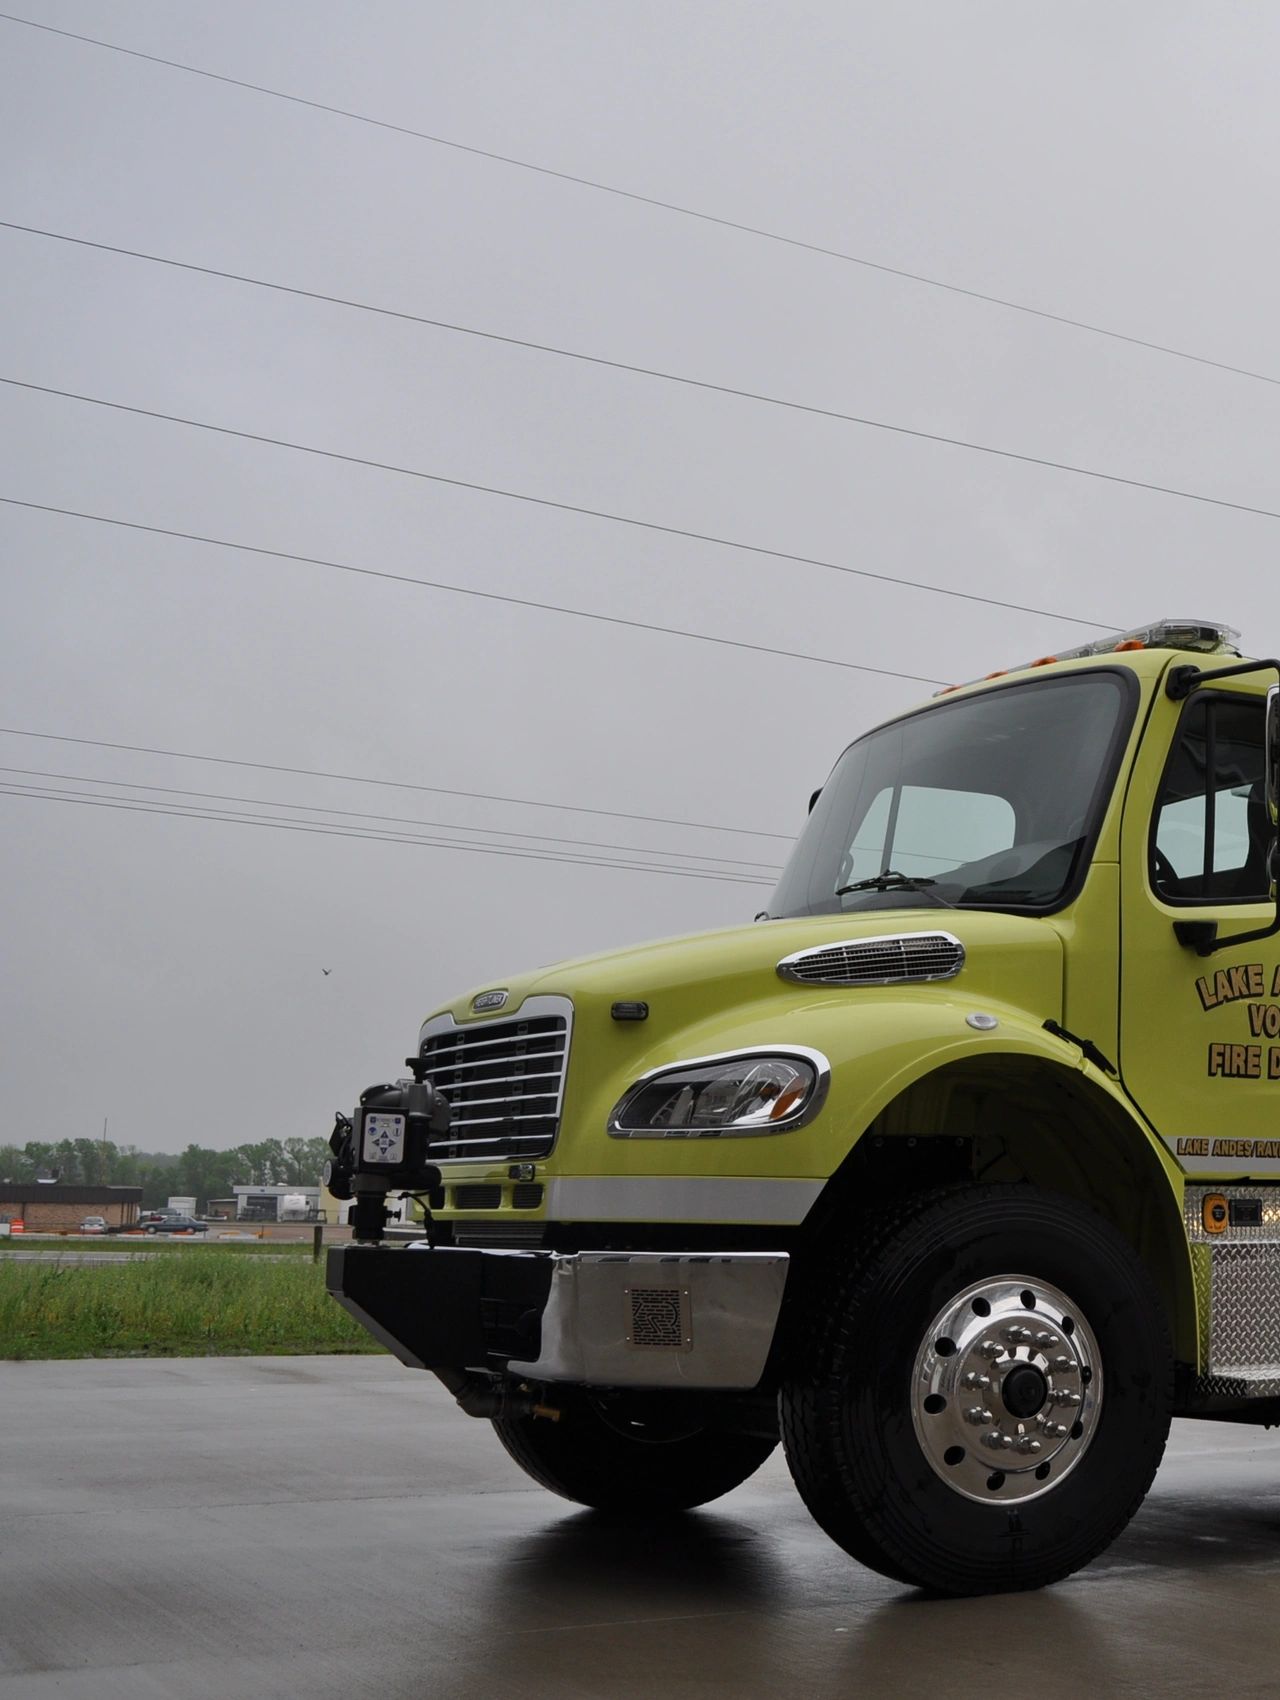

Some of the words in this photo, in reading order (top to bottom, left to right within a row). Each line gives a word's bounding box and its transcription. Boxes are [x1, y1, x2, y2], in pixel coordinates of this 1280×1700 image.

[1195, 963, 1264, 1011] LAKE
[1208, 1042, 1262, 1078] FIRE
[1177, 1138, 1209, 1157] LAKE
